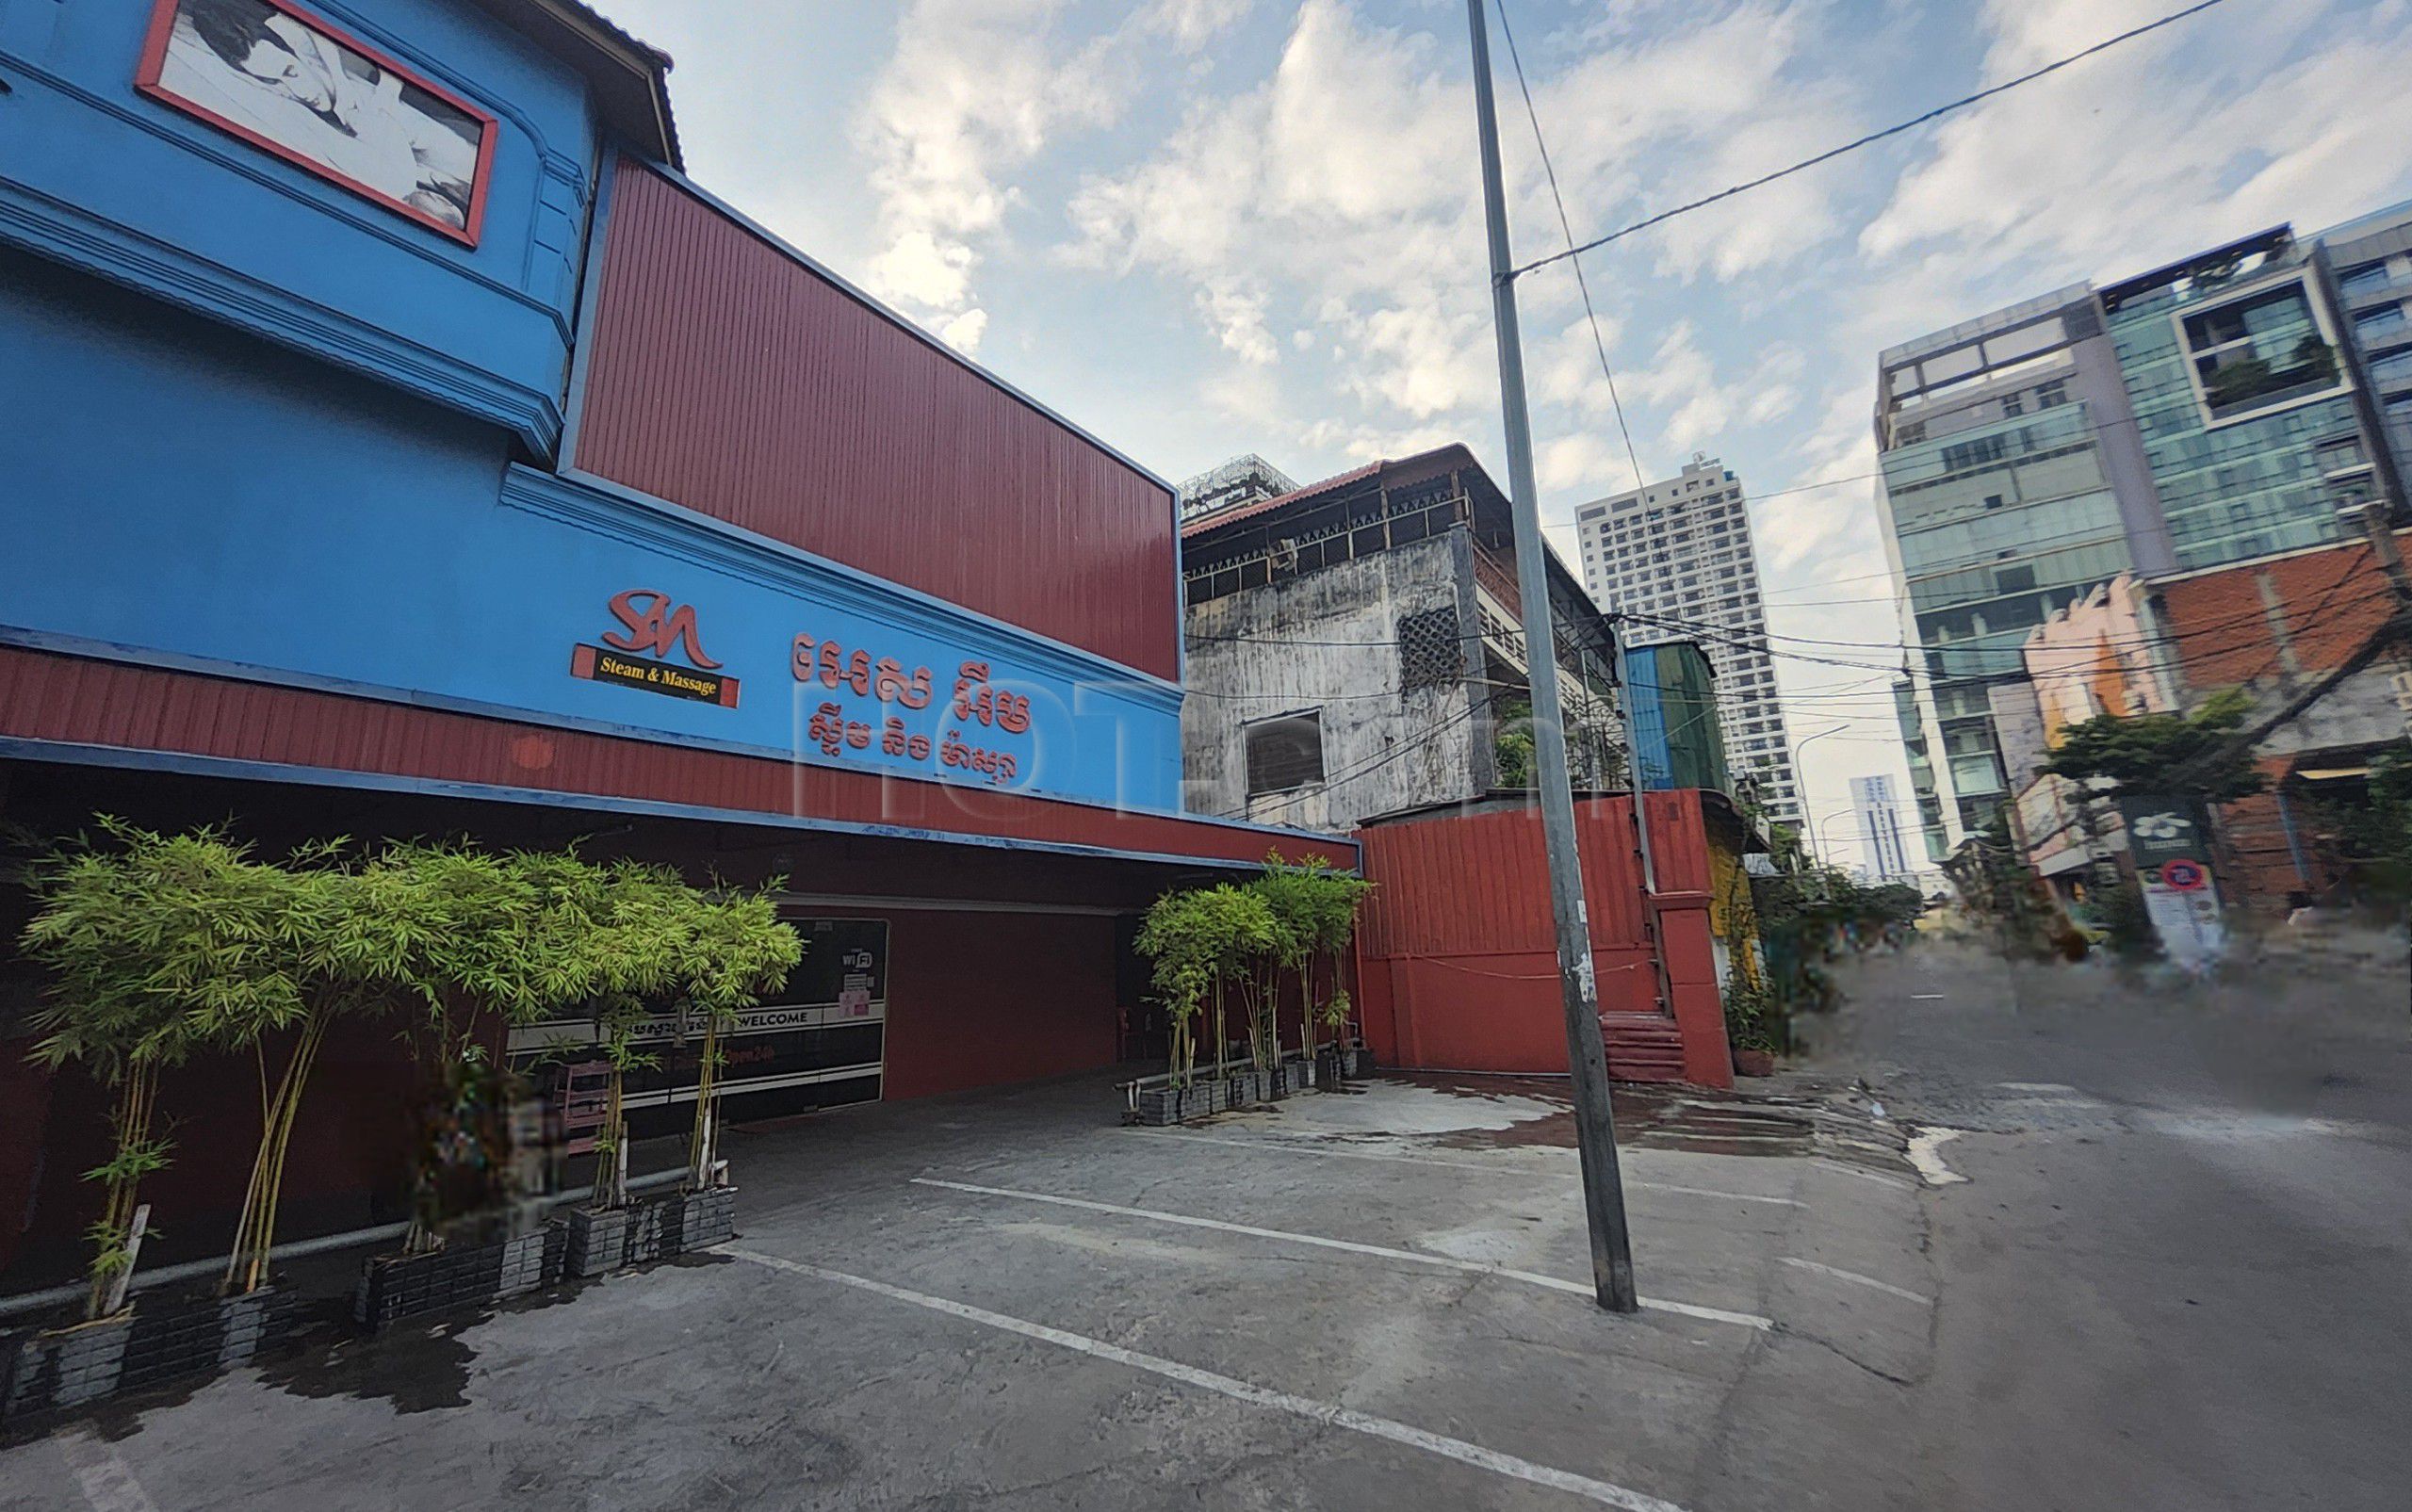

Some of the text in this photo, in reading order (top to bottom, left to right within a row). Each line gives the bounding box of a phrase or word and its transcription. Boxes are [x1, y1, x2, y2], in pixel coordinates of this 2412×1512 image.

[600, 657, 716, 696] Steam & Massage
[883, 716, 931, 760] និង
[738, 1013, 807, 1027] WELCOME
